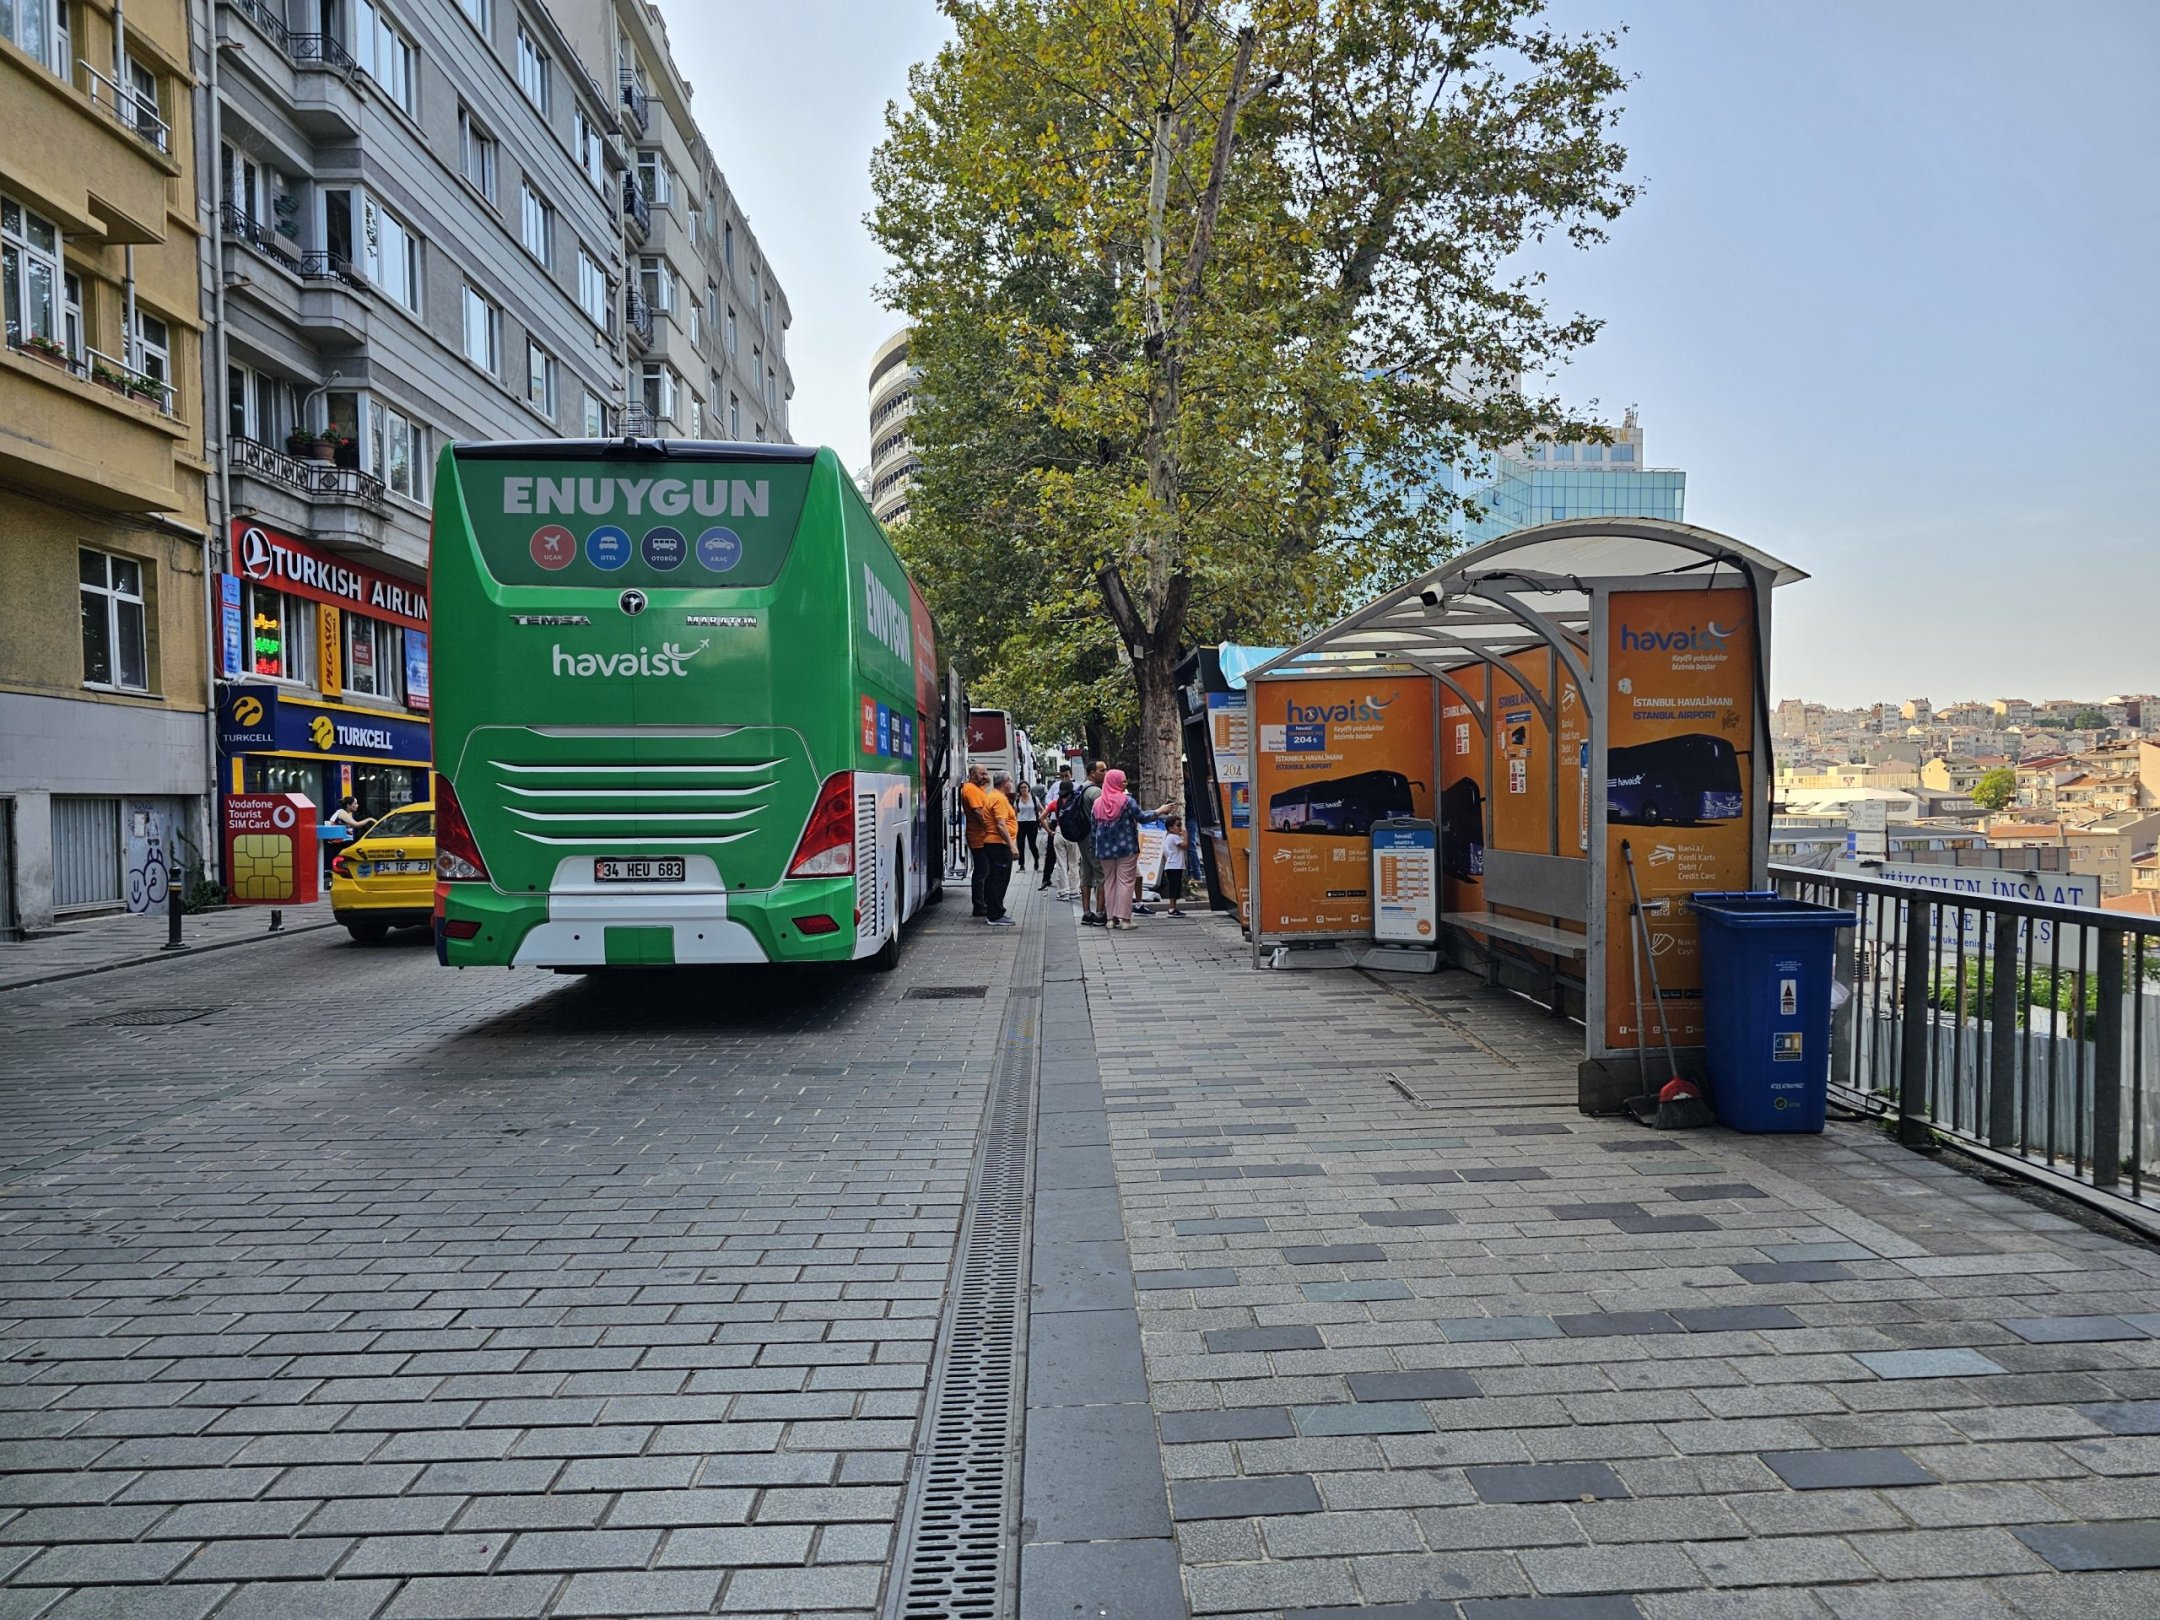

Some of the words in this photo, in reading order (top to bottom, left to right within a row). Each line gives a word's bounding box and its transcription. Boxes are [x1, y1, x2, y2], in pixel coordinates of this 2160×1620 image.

[503, 476, 770, 517] ENUYGUN
[544, 554, 562, 562] UÇAK
[651, 554, 678, 562] OTOBÜS
[710, 555, 728, 563] ARAÇ
[271, 545, 362, 601] TURKISH
[864, 561, 911, 667] ENUYGUN
[509, 615, 592, 626] TEMSA
[686, 615, 758, 628] MARATON
[1621, 621, 1730, 651] havaist
[323, 608, 333, 689] PEGASUS
[552, 641, 690, 677] havaist
[1633, 696, 1676, 707] İSTANBUL
[1677, 695, 1733, 706] HAVALİMANI
[1287, 694, 1385, 722] havaist
[1677, 711, 1716, 720] AIRPORT
[224, 733, 274, 742] TURKCELL
[337, 725, 393, 750] TURKCELL
[1617, 774, 1642, 787] havaist
[228, 800, 273, 809] Vodafone
[228, 810, 262, 818] Tourist
[228, 820, 247, 829] SIM
[248, 820, 271, 829] Card
[380, 861, 390, 871] 34
[395, 862, 410, 871] TGF
[418, 861, 428, 871] 23
[604, 863, 619, 877] 34
[627, 863, 650, 877] HEU
[658, 863, 682, 877] 683
[1678, 872, 1698, 880] Credit
